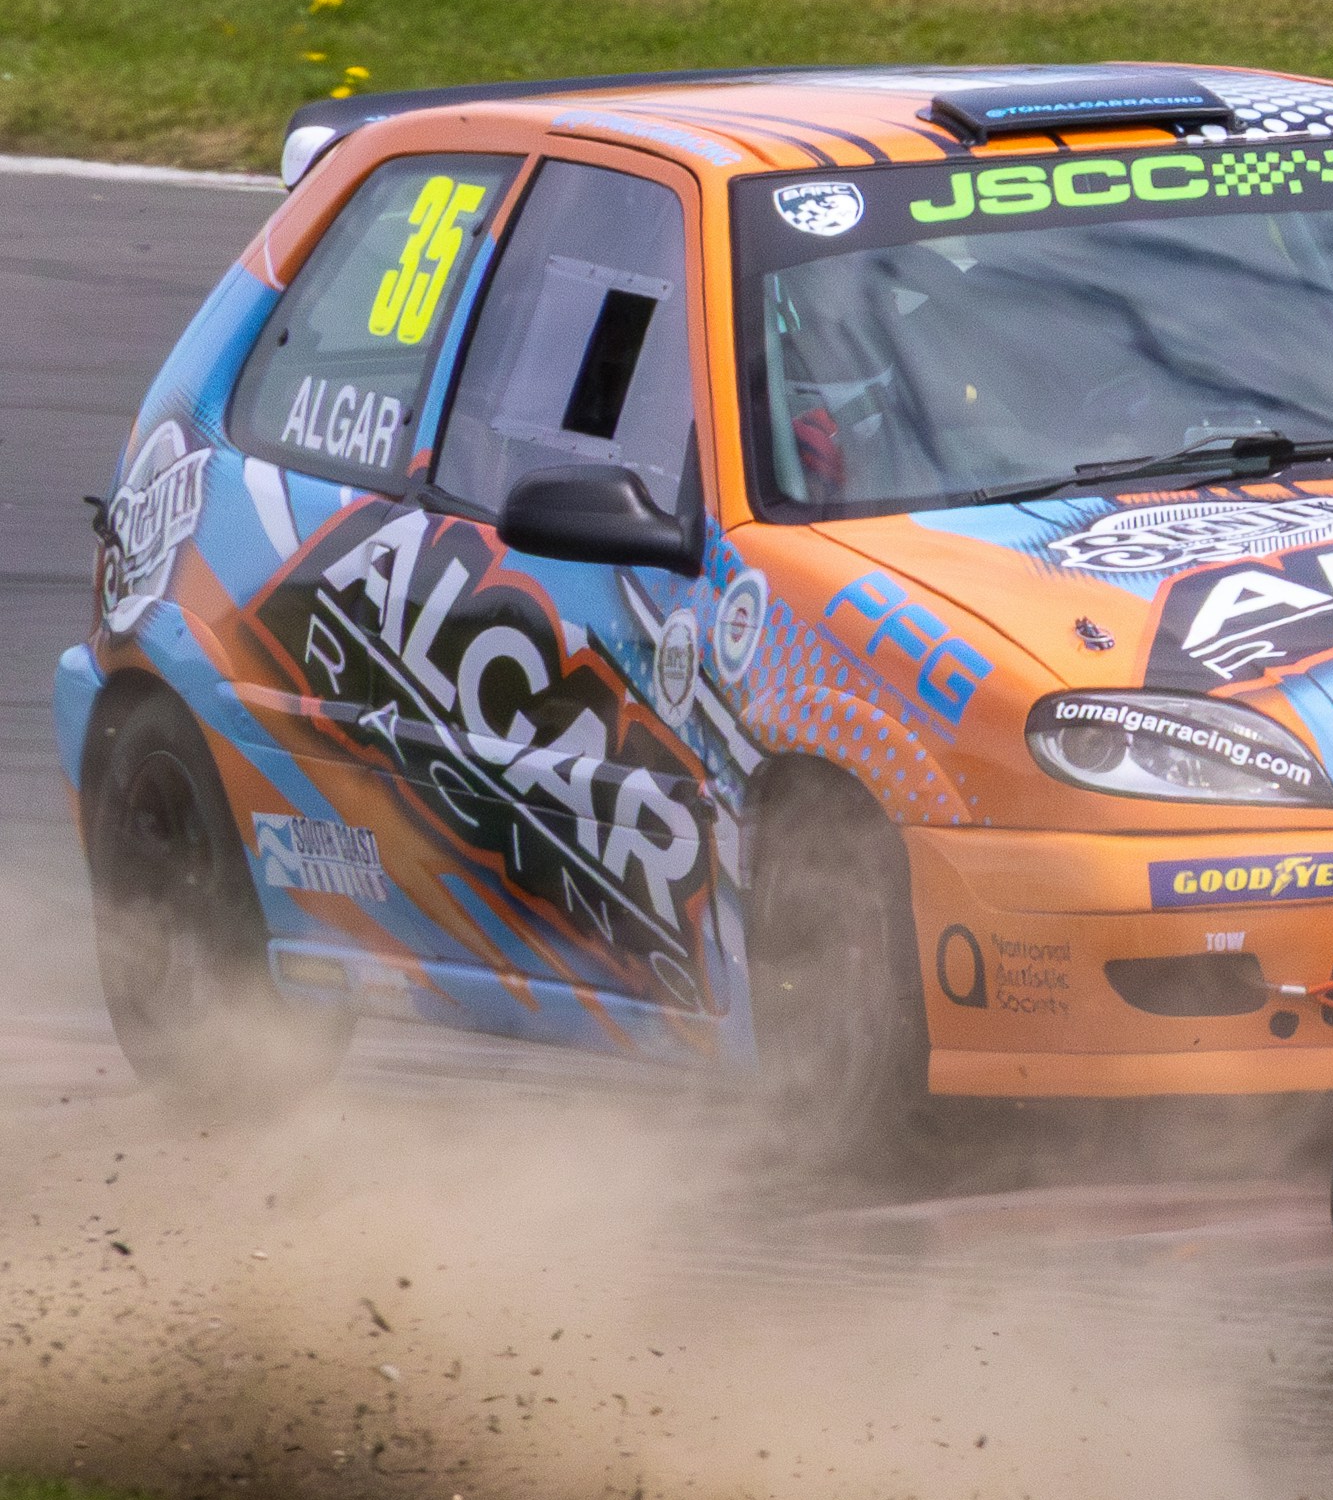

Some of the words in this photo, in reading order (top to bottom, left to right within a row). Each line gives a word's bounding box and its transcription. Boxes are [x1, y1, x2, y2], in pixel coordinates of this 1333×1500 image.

[909, 154, 1208, 223] JSCC
[368, 175, 486, 344] 35
[281, 375, 401, 468] ALGAR
[823, 570, 995, 727] PFG
[322, 508, 698, 932] ALGAR
[1056, 701, 1311, 785] tomalgarracing.com
[1205, 931, 1245, 952] TOW
